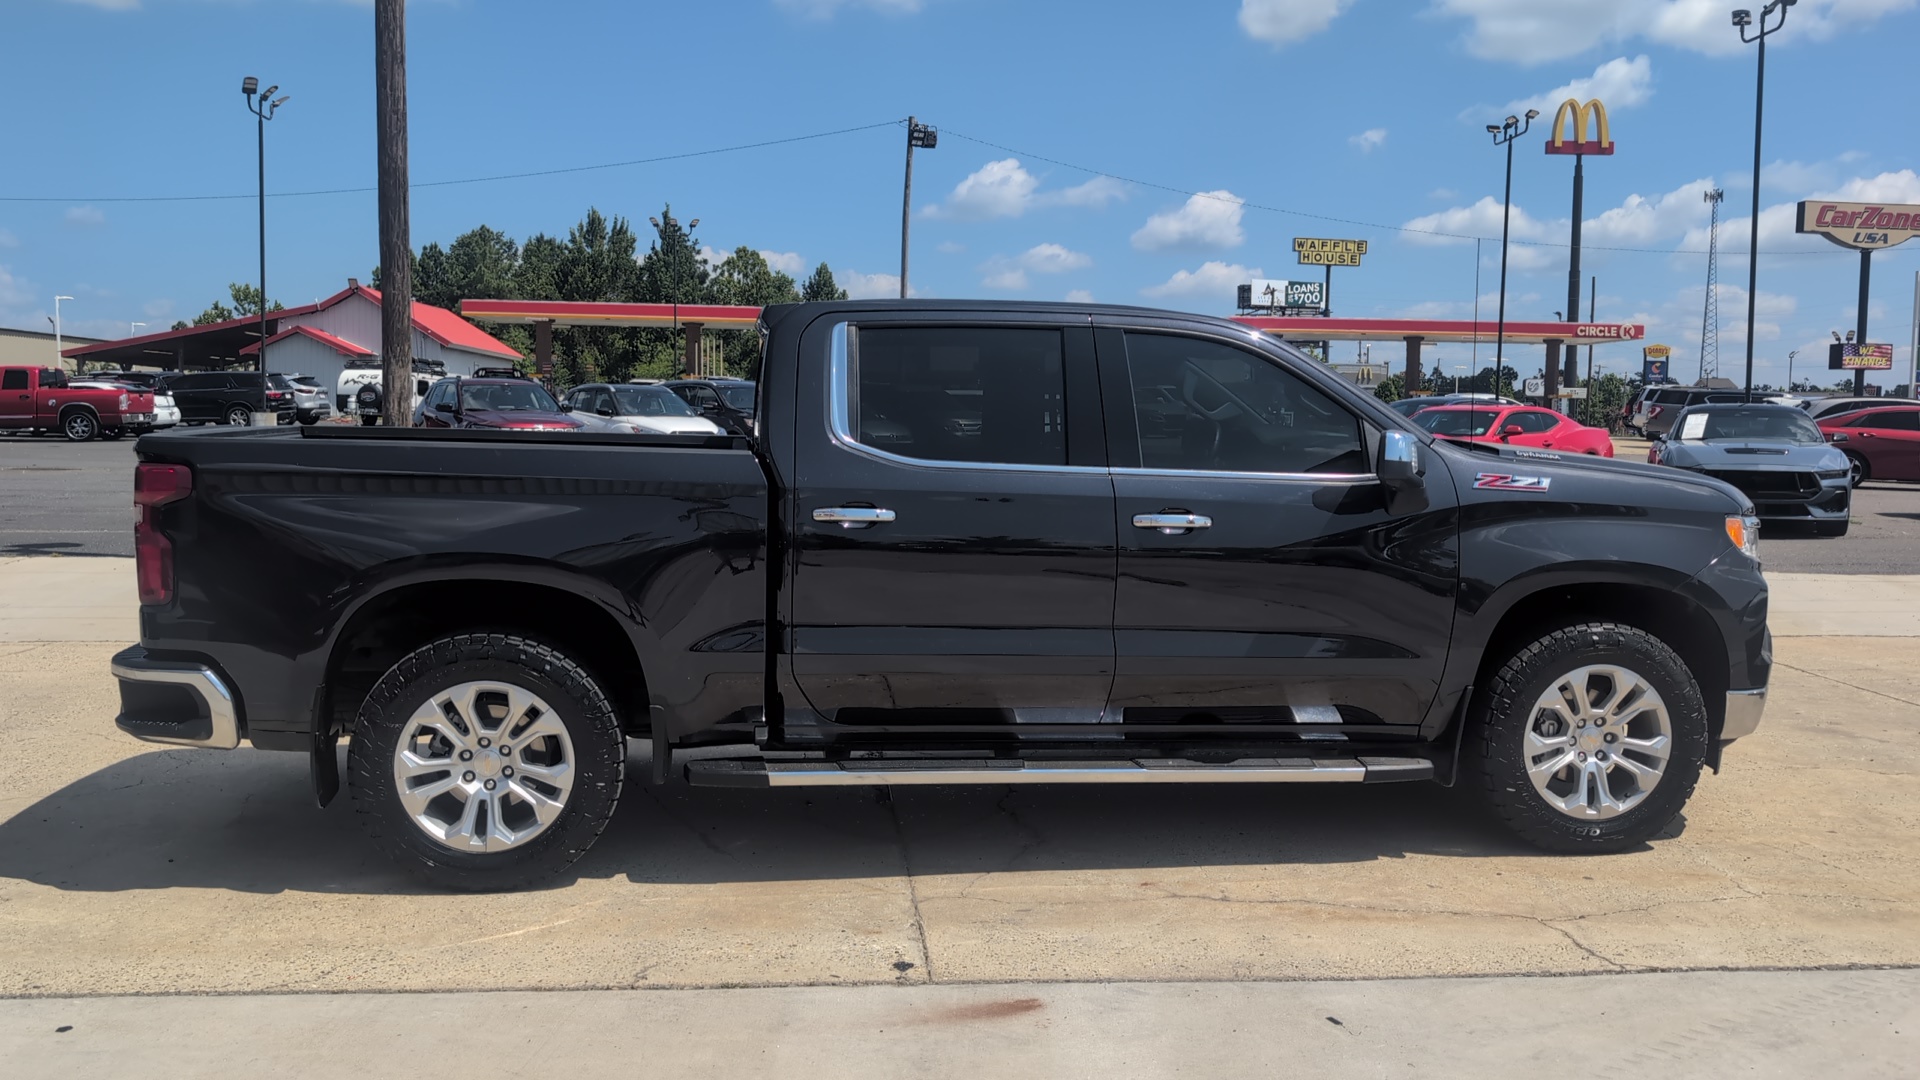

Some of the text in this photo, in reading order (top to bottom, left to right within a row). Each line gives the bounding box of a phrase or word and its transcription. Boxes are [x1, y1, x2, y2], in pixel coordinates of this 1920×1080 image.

[1815, 204, 1920, 230] CarZone
[1852, 232, 1888, 244] USA
[1296, 240, 1365, 252] WAFFLE
[1302, 252, 1358, 264] HOUSE
[1288, 283, 1320, 294] LOANS
[1294, 292, 1320, 304] $700
[1576, 325, 1634, 339] CIRCLE K
[1859, 345, 1875, 354] WE
[1845, 356, 1888, 366] FINANCE
